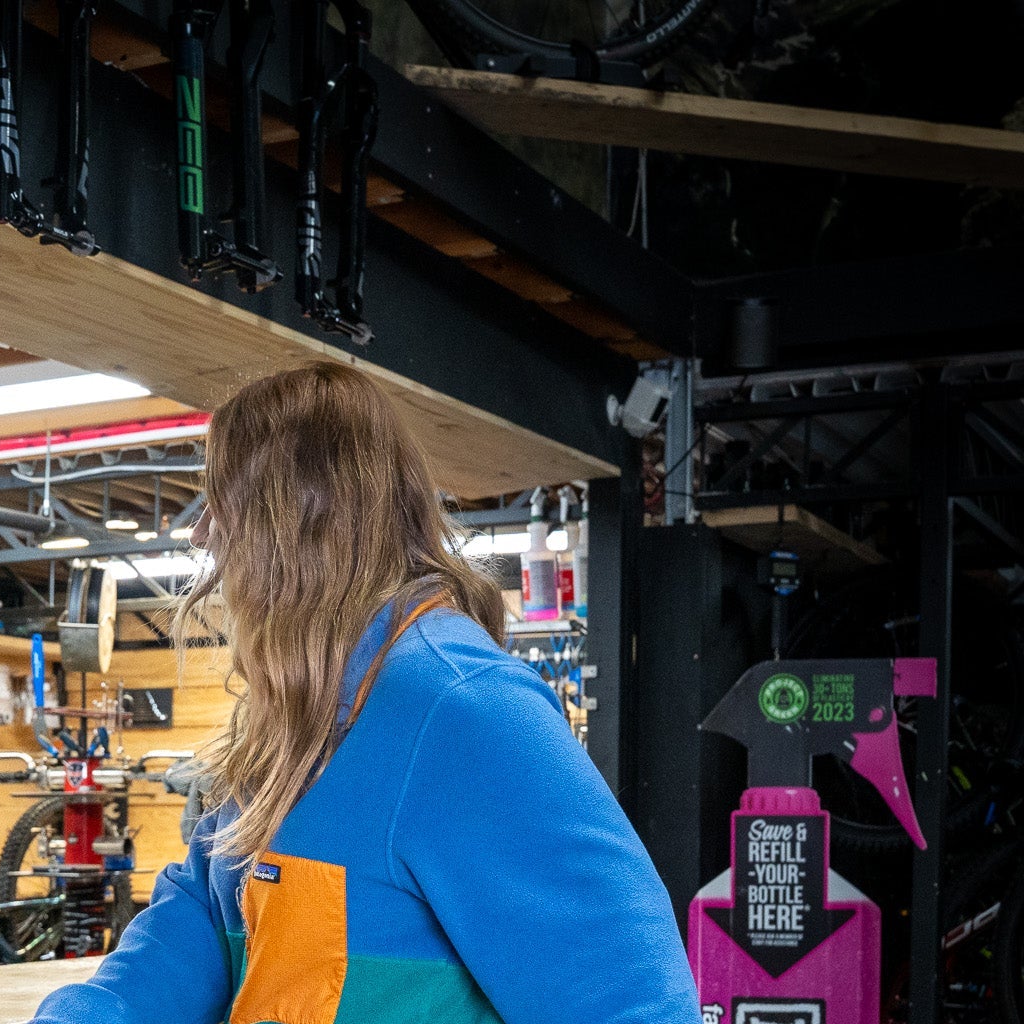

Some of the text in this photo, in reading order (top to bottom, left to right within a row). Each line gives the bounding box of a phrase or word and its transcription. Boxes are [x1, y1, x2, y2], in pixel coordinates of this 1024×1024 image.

[646, 0, 702, 43] ARTELLO
[813, 702, 854, 721] 2023
[748, 819, 807, 842] Save &
[748, 842, 806, 863] REFILL
[748, 885, 804, 904] BOTTLE
